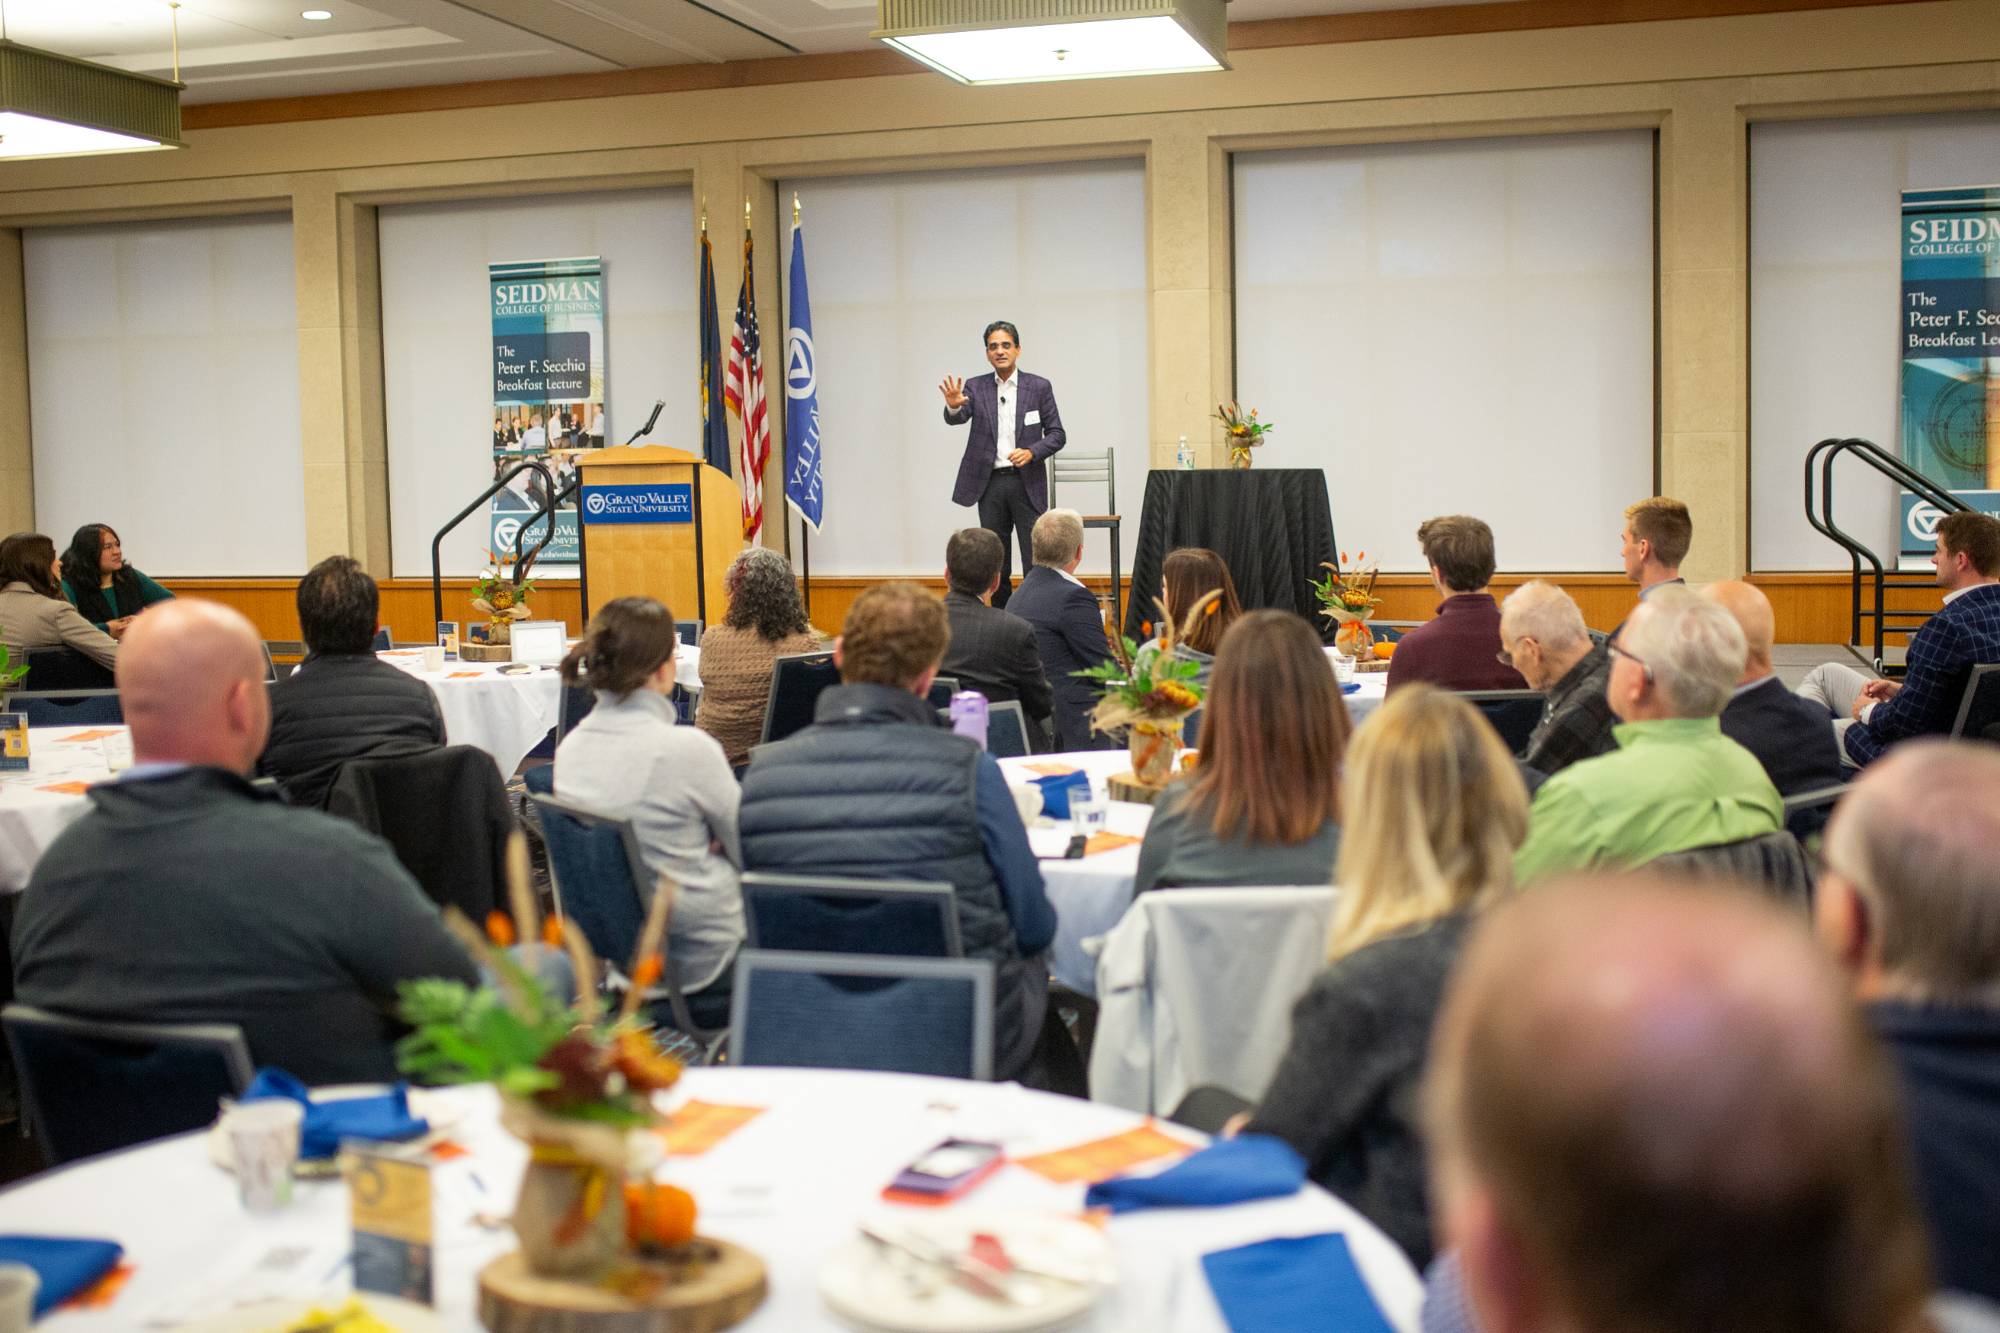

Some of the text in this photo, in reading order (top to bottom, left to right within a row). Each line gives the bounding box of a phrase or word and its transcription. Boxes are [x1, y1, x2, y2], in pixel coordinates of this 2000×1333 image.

[1909, 242, 1994, 256] COLLEGE OF
[495, 281, 600, 305] SEIDMAN
[1907, 292, 1937, 306] The
[495, 302, 600, 316] COLLEGE OF BUSINESS
[1910, 311, 1951, 327] Peter
[1957, 310, 1970, 326] F.
[1908, 331, 2000, 348] Breakfast Le
[497, 345, 515, 357] The
[498, 358, 586, 375] Peter F. Secchia
[497, 378, 583, 392] Breakfast Lecture
[605, 492, 689, 505] GRAND VALLEY
[605, 504, 633, 514] STATE
[525, 525, 561, 536] GRAD
